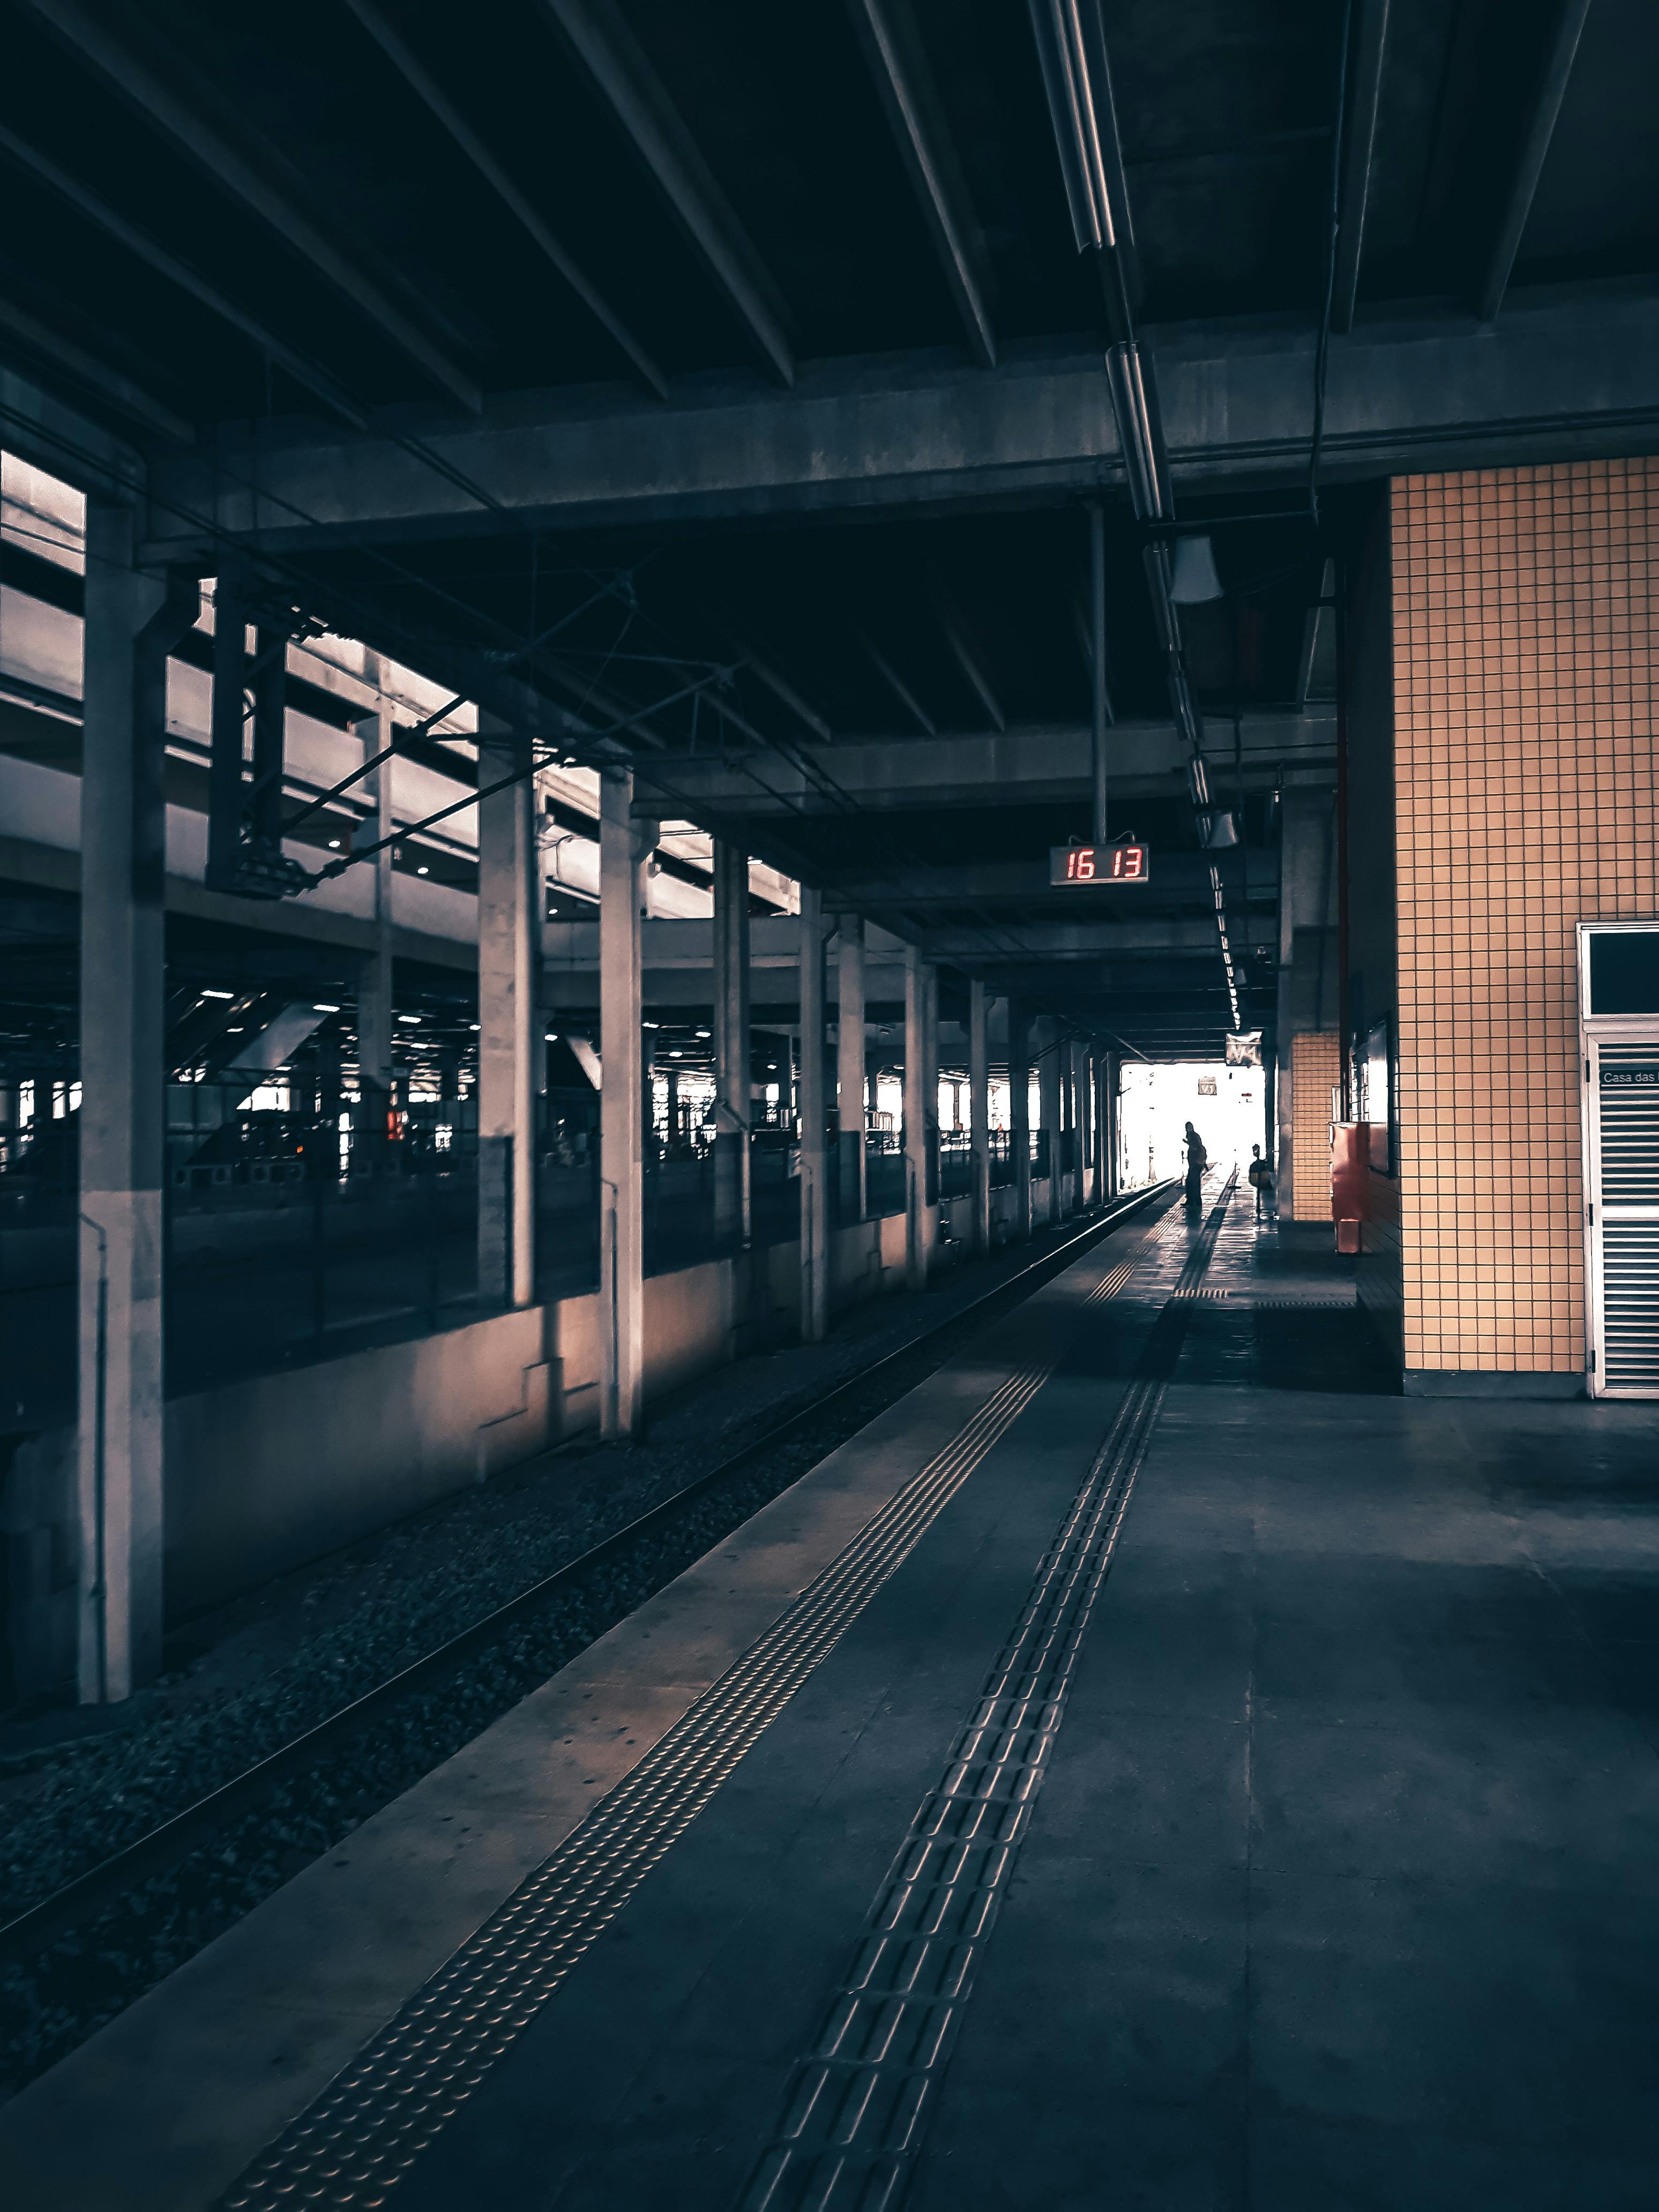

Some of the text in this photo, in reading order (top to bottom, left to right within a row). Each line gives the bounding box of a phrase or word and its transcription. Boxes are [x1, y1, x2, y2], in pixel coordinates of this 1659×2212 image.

[1067, 847, 1142, 879] 16 13
[1604, 1073, 1632, 1082] Casa
[1635, 1072, 1655, 1081] das
